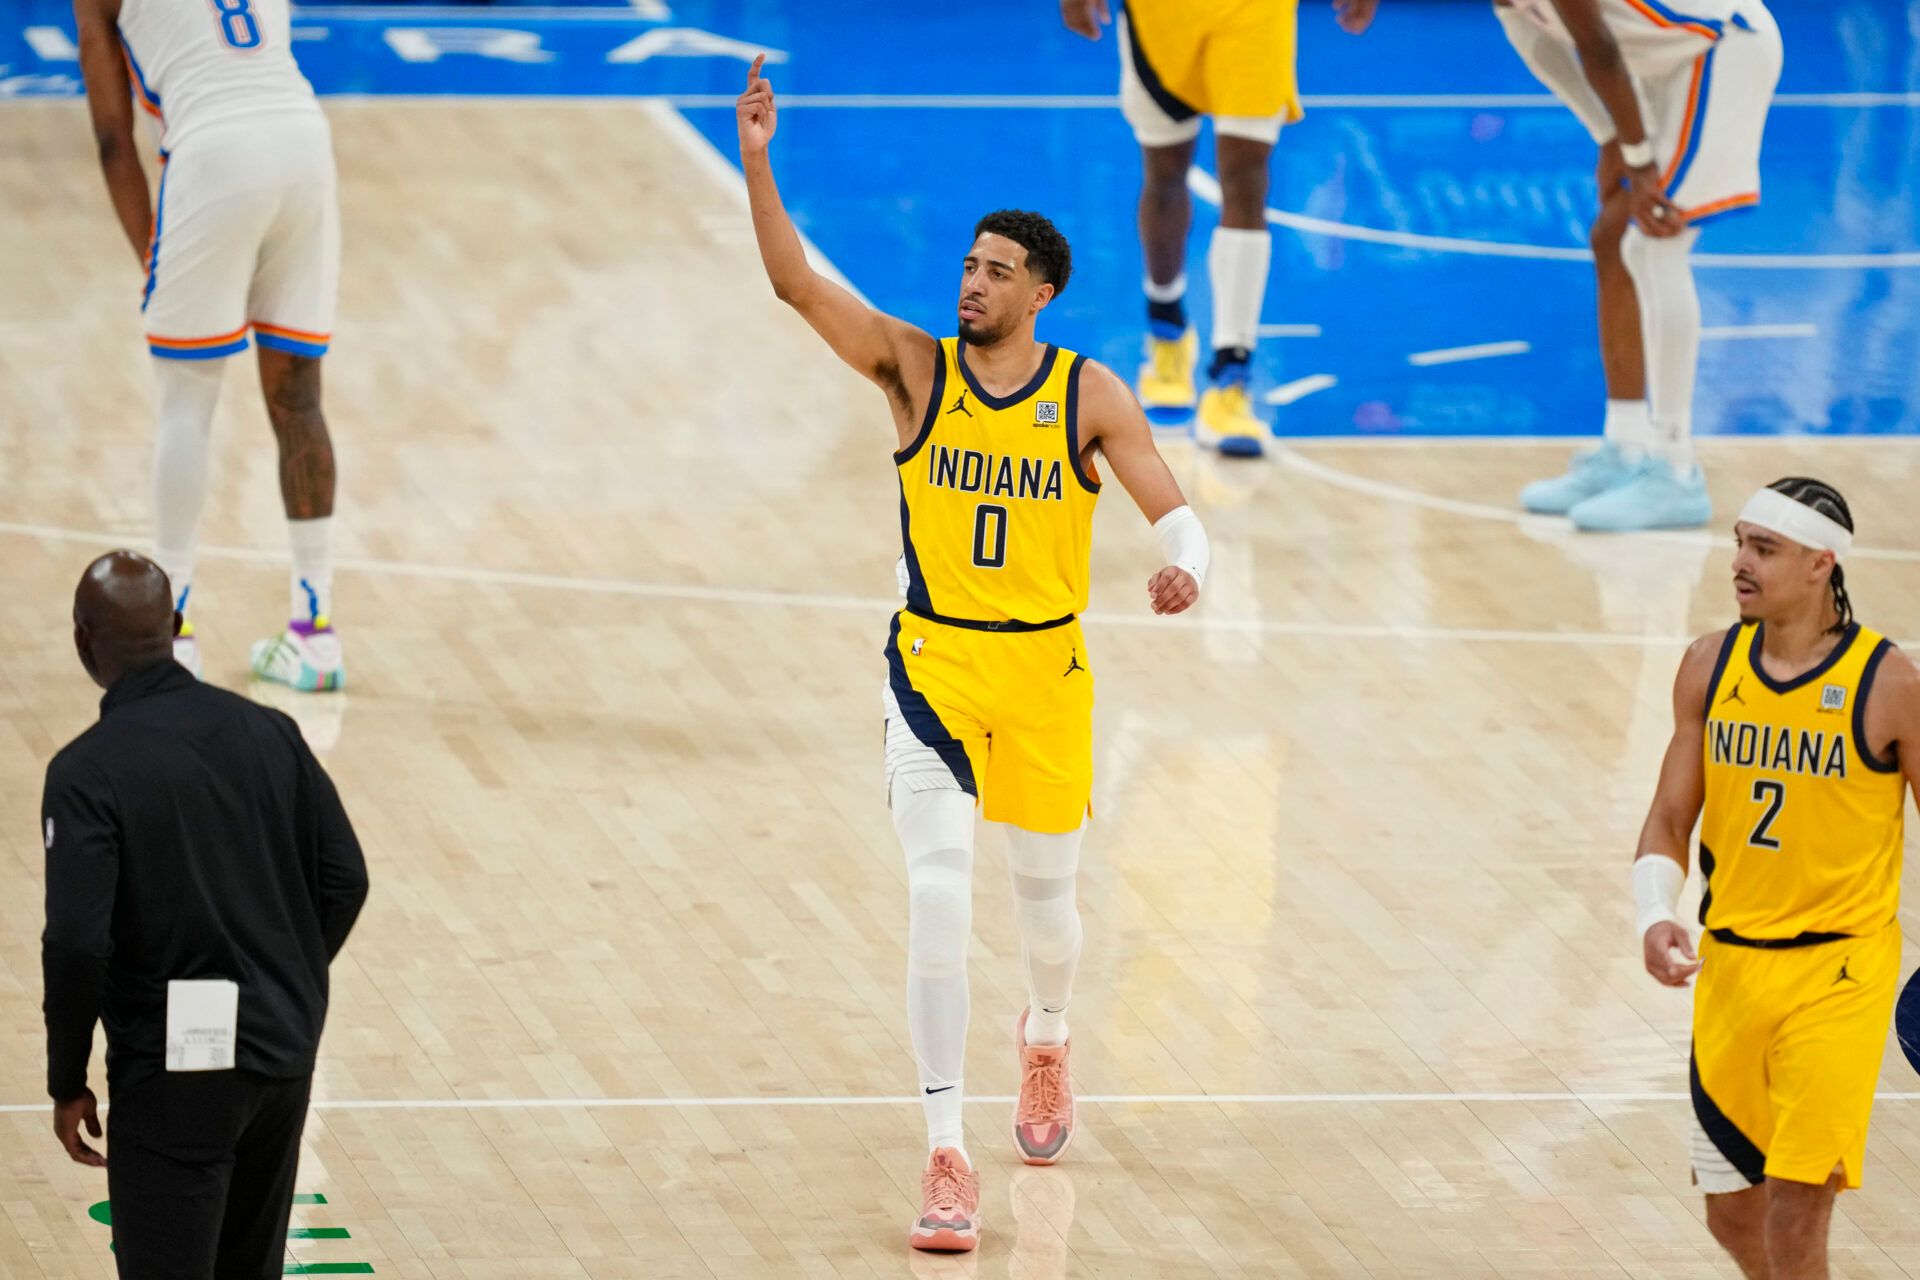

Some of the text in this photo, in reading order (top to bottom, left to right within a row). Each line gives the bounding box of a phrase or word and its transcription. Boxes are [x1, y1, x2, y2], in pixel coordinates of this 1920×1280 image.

[209, 0, 265, 52] 8
[929, 444, 1063, 501] INDIANA
[971, 503, 1008, 569] 0
[1708, 720, 1847, 779] INDIANA
[1747, 779, 1786, 851] 2
